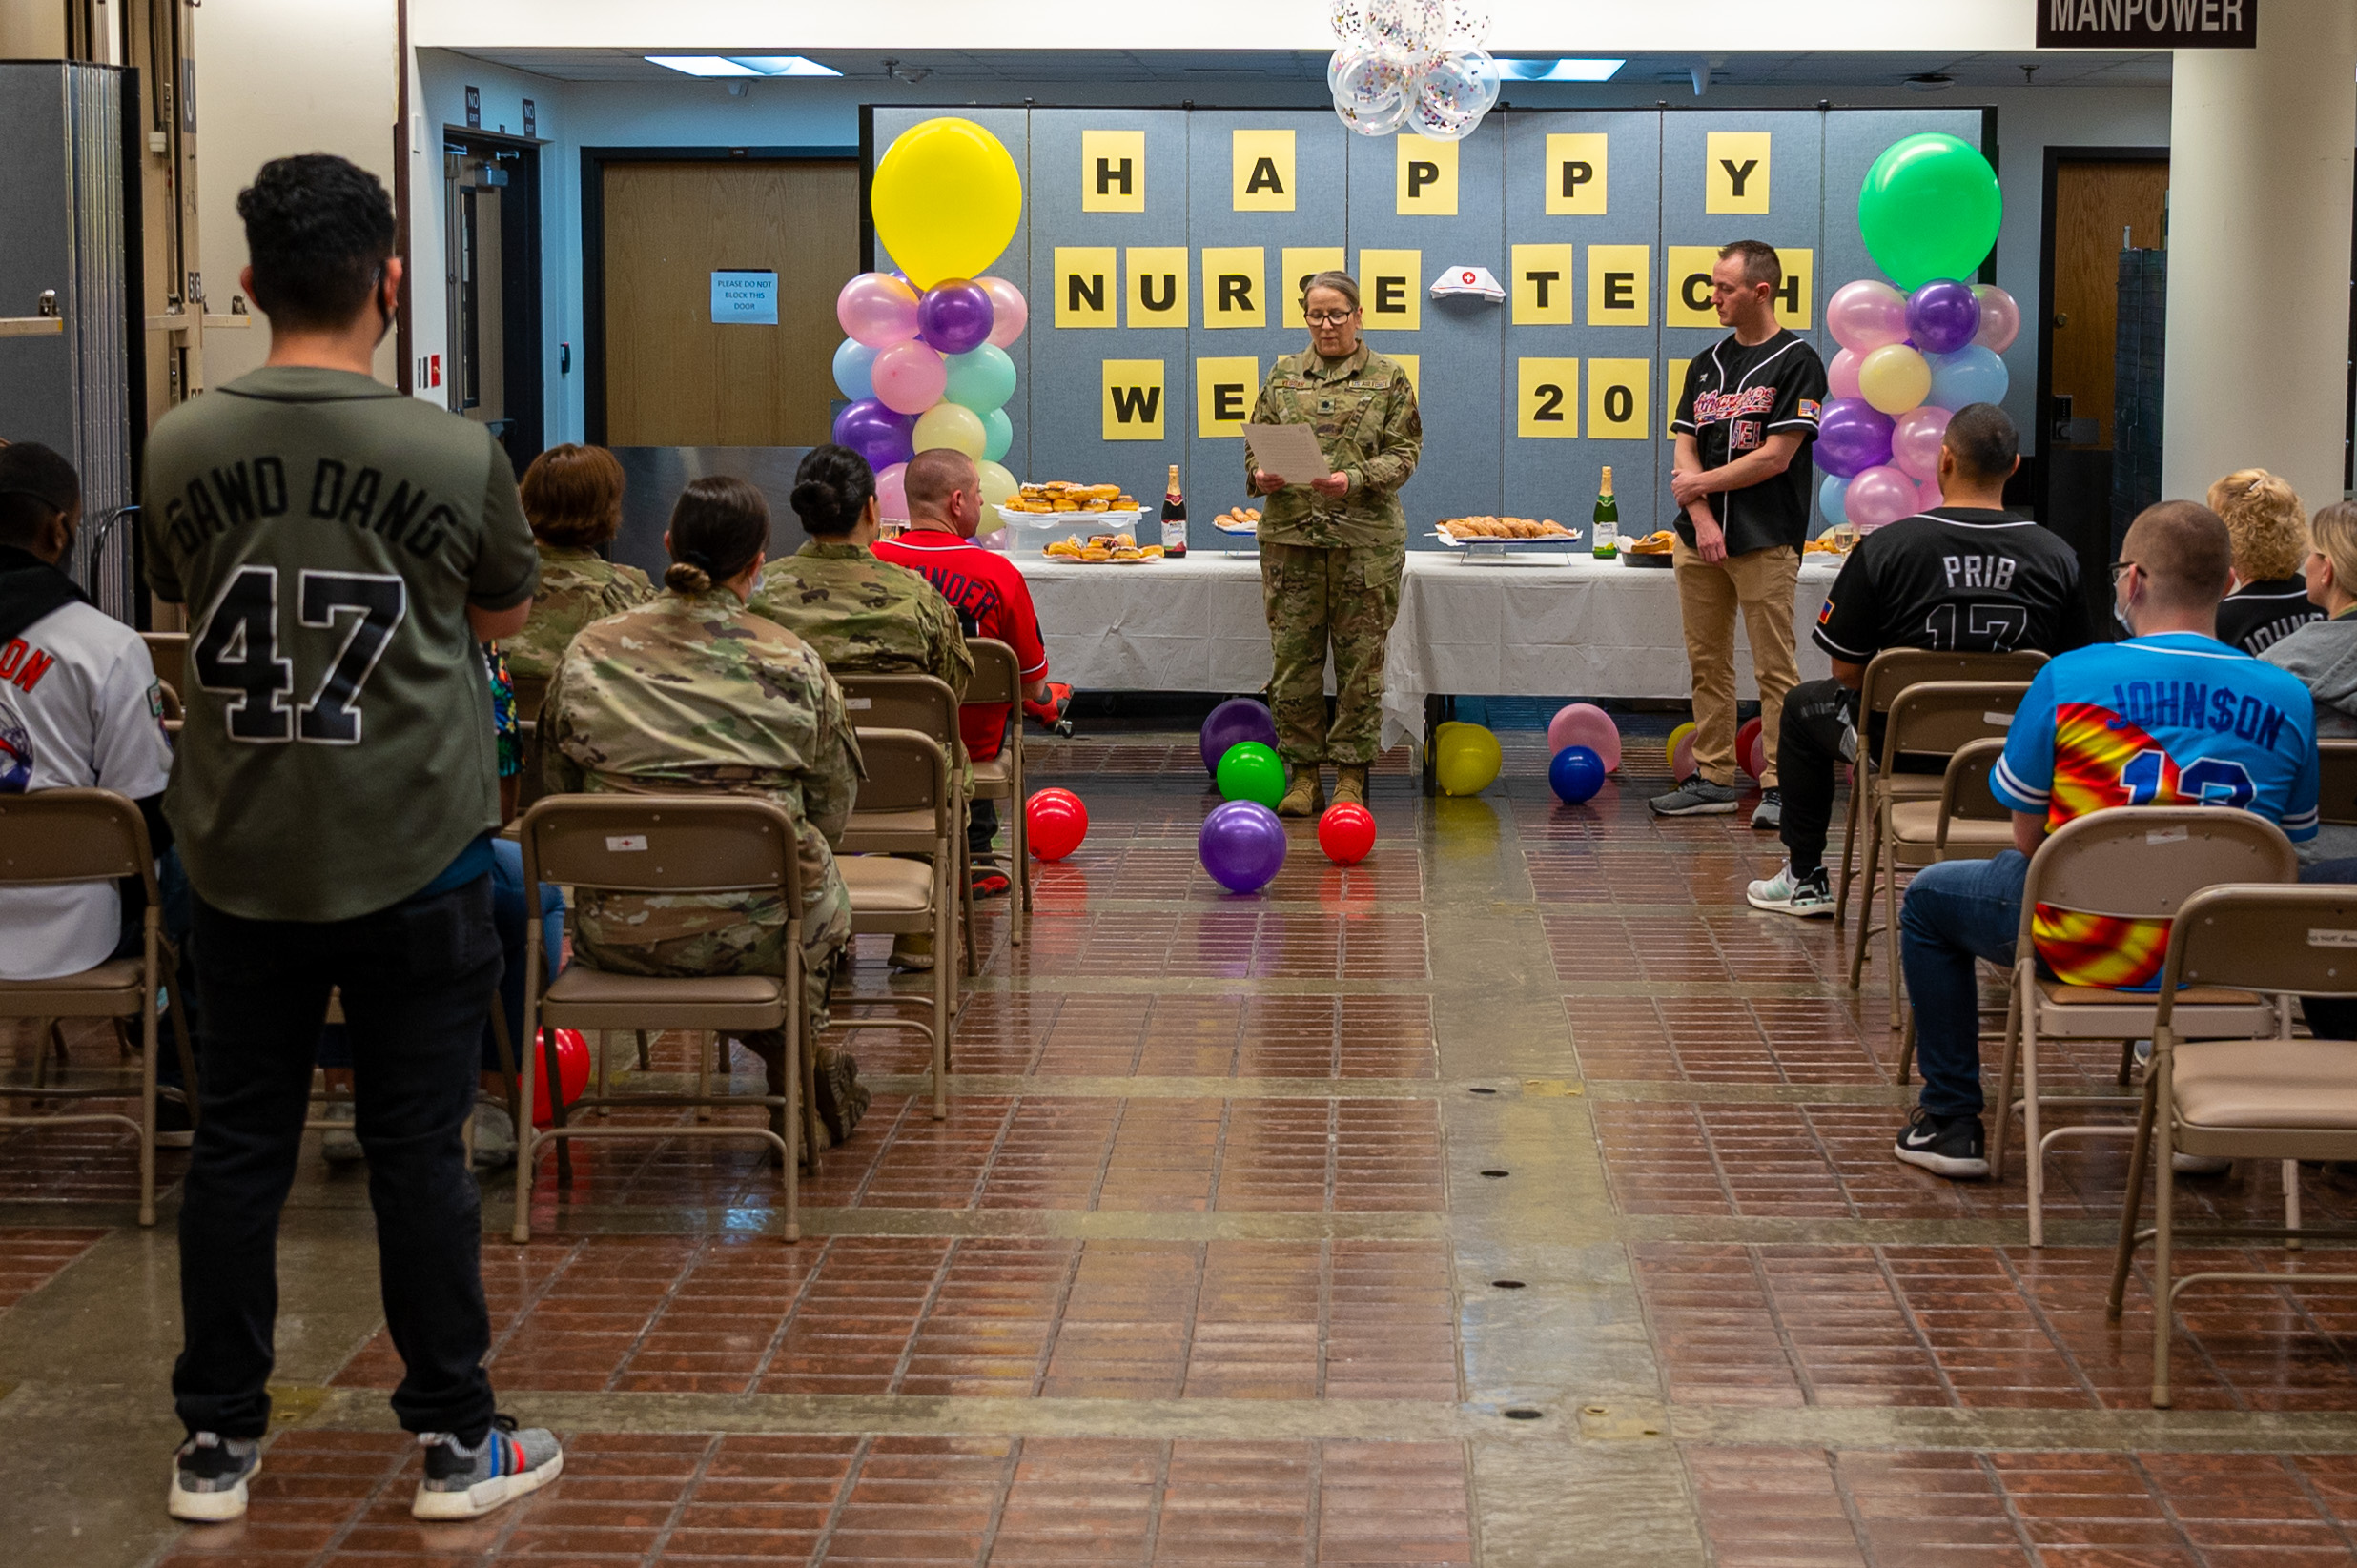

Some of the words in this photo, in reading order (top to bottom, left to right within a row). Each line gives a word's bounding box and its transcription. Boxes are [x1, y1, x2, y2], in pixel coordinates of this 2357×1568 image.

[2049, 0, 2243, 31] MANPOWER
[467, 92, 479, 109] NO
[523, 104, 534, 119] NO
[1110, 383, 1246, 423] WE
[1533, 384, 1634, 423] 20
[165, 456, 289, 555] GAWD
[309, 458, 458, 558] DANG
[1942, 555, 2017, 591] PRIB
[192, 564, 407, 744] 47
